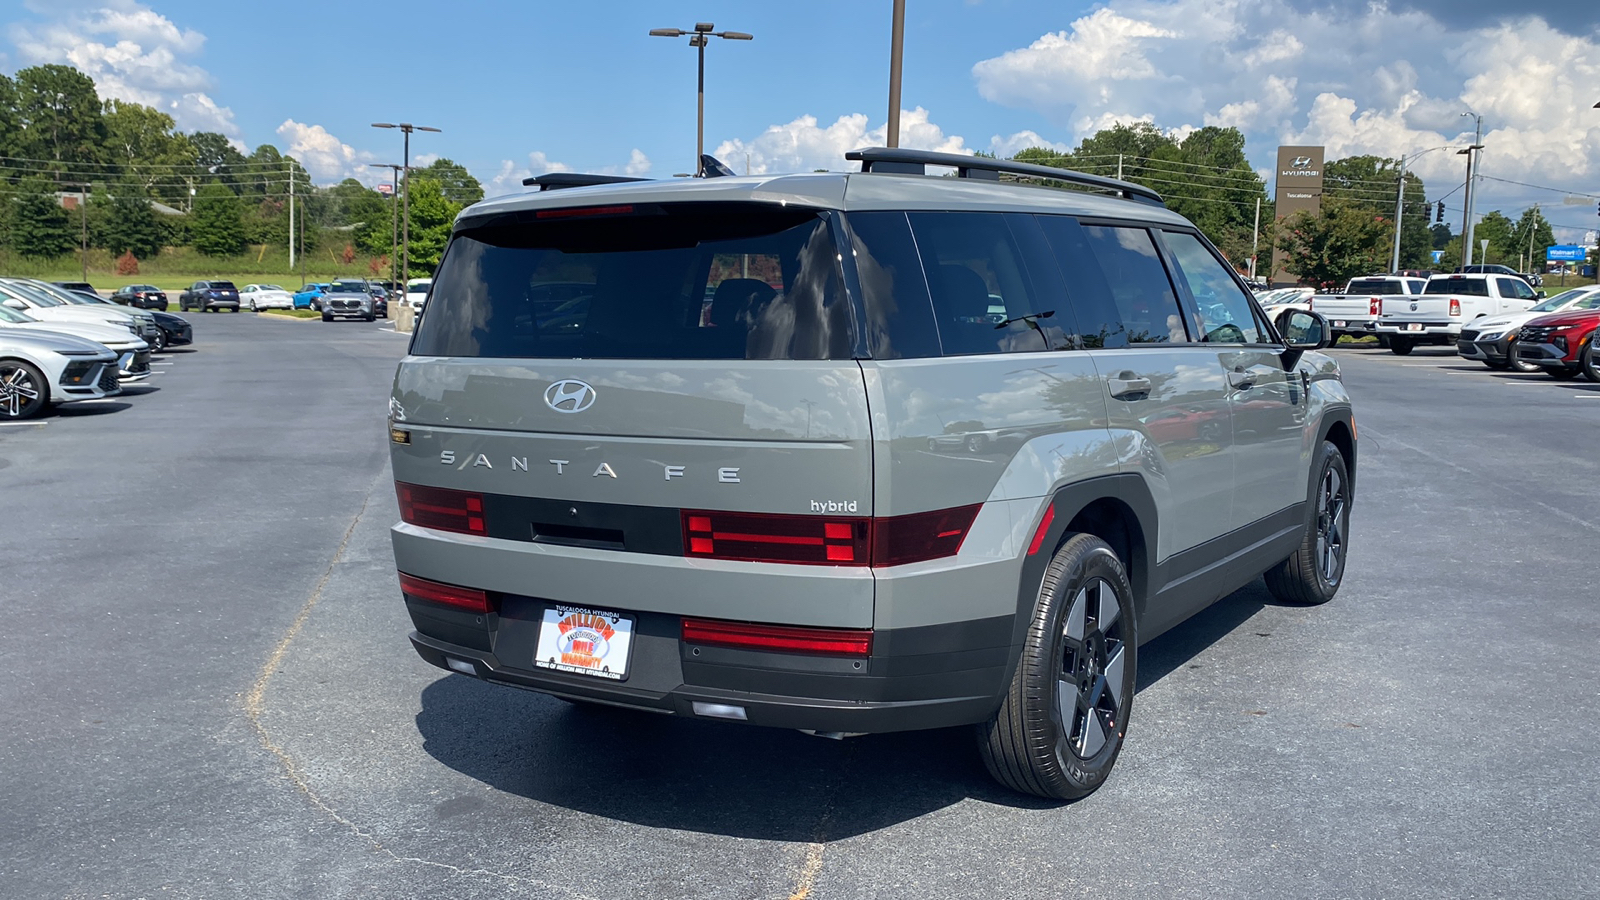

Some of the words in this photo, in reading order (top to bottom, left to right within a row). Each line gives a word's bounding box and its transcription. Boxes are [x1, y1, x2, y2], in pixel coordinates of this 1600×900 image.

[440, 450, 617, 479] SANTA
[664, 465, 741, 483] FE
[810, 499, 857, 514] hybrid
[556, 605, 591, 615] TUSCALOOSA
[592, 610, 620, 618] HYUNDAI
[558, 613, 615, 641] MILLION
[572, 640, 594, 656] MILE
[556, 664, 575, 672] MILLION
[561, 652, 602, 669] WARRANTY
